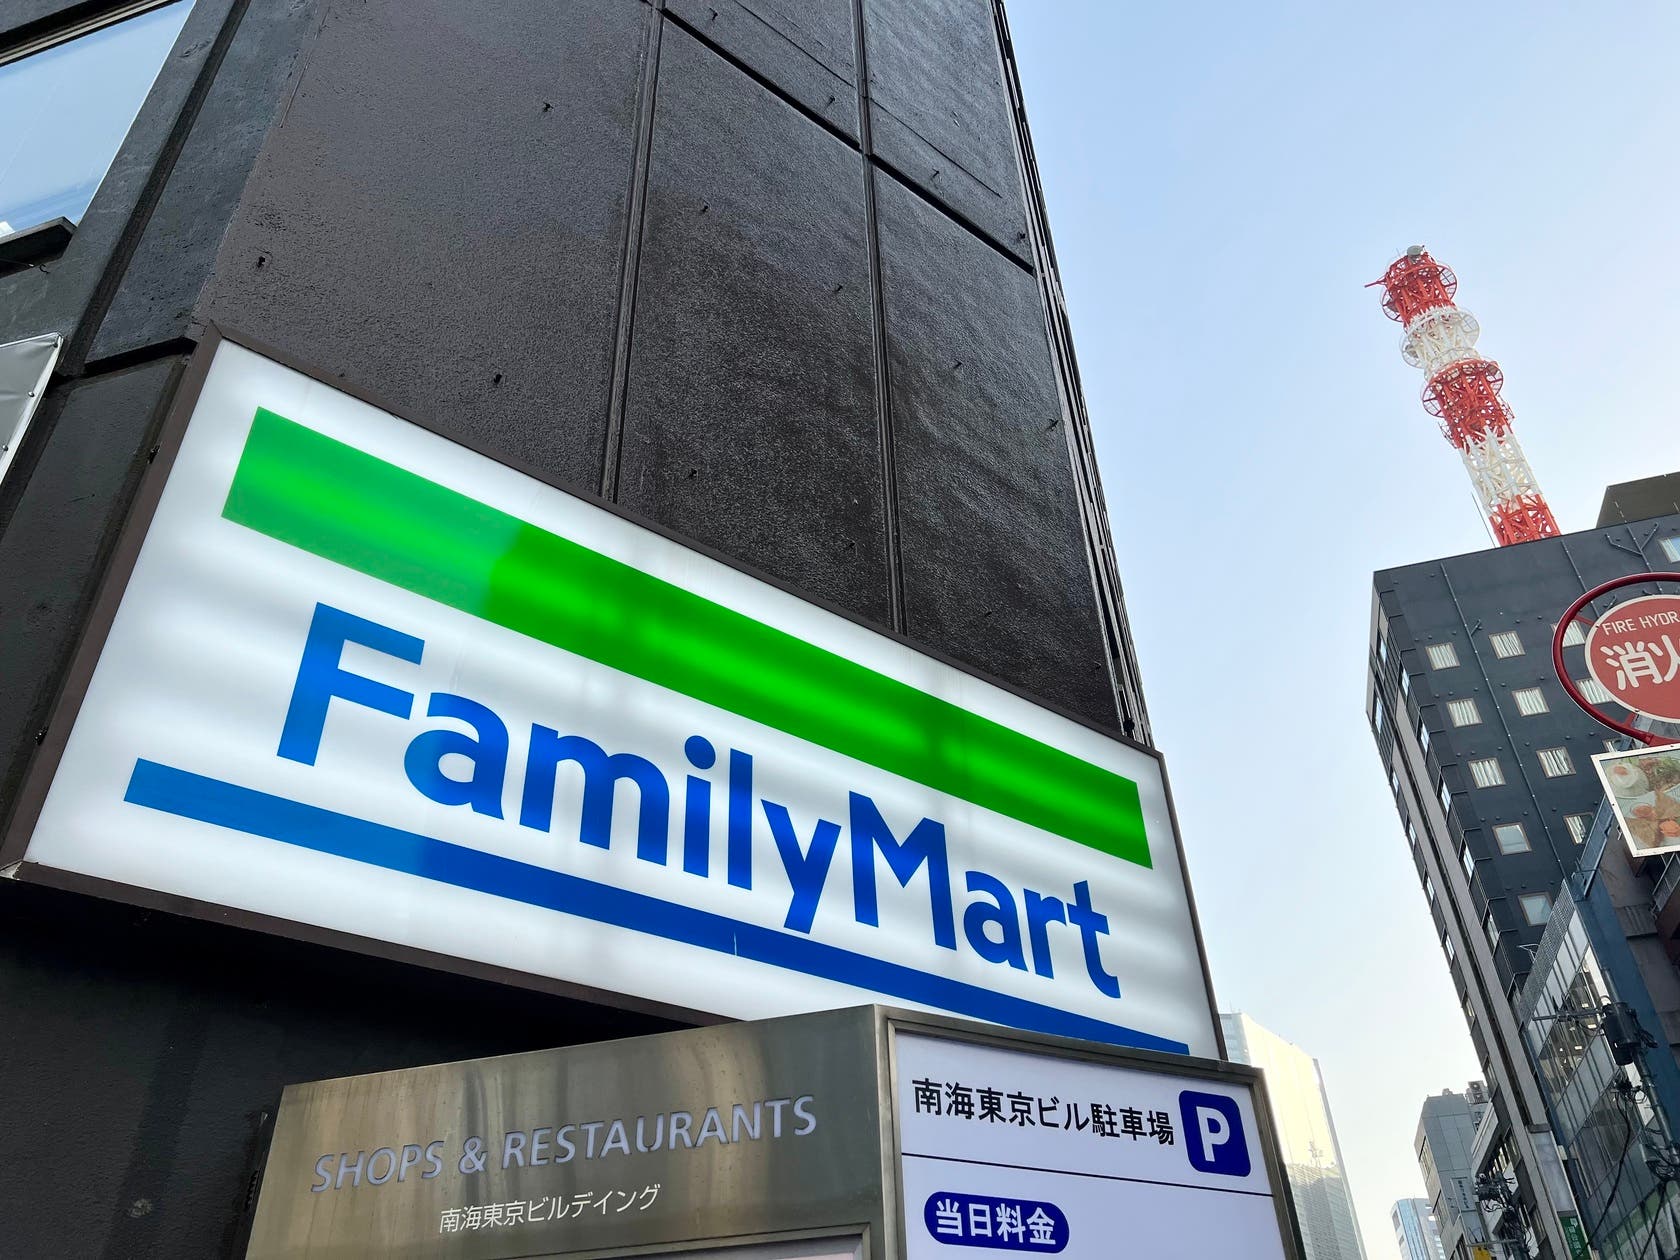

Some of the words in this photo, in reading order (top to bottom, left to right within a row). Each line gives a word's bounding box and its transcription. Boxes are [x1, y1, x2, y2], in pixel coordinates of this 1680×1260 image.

[1602, 618, 1637, 635] FIRE
[277, 602, 1121, 999] FamilyMart
[911, 1077, 1176, 1147] 南海東京ビル駐車場
[1196, 1106, 1231, 1162] P
[310, 1140, 445, 1193] SHOPS
[458, 1135, 488, 1174] &
[501, 1095, 818, 1170] RESTAURANTS
[935, 1198, 1057, 1246] 当日料金
